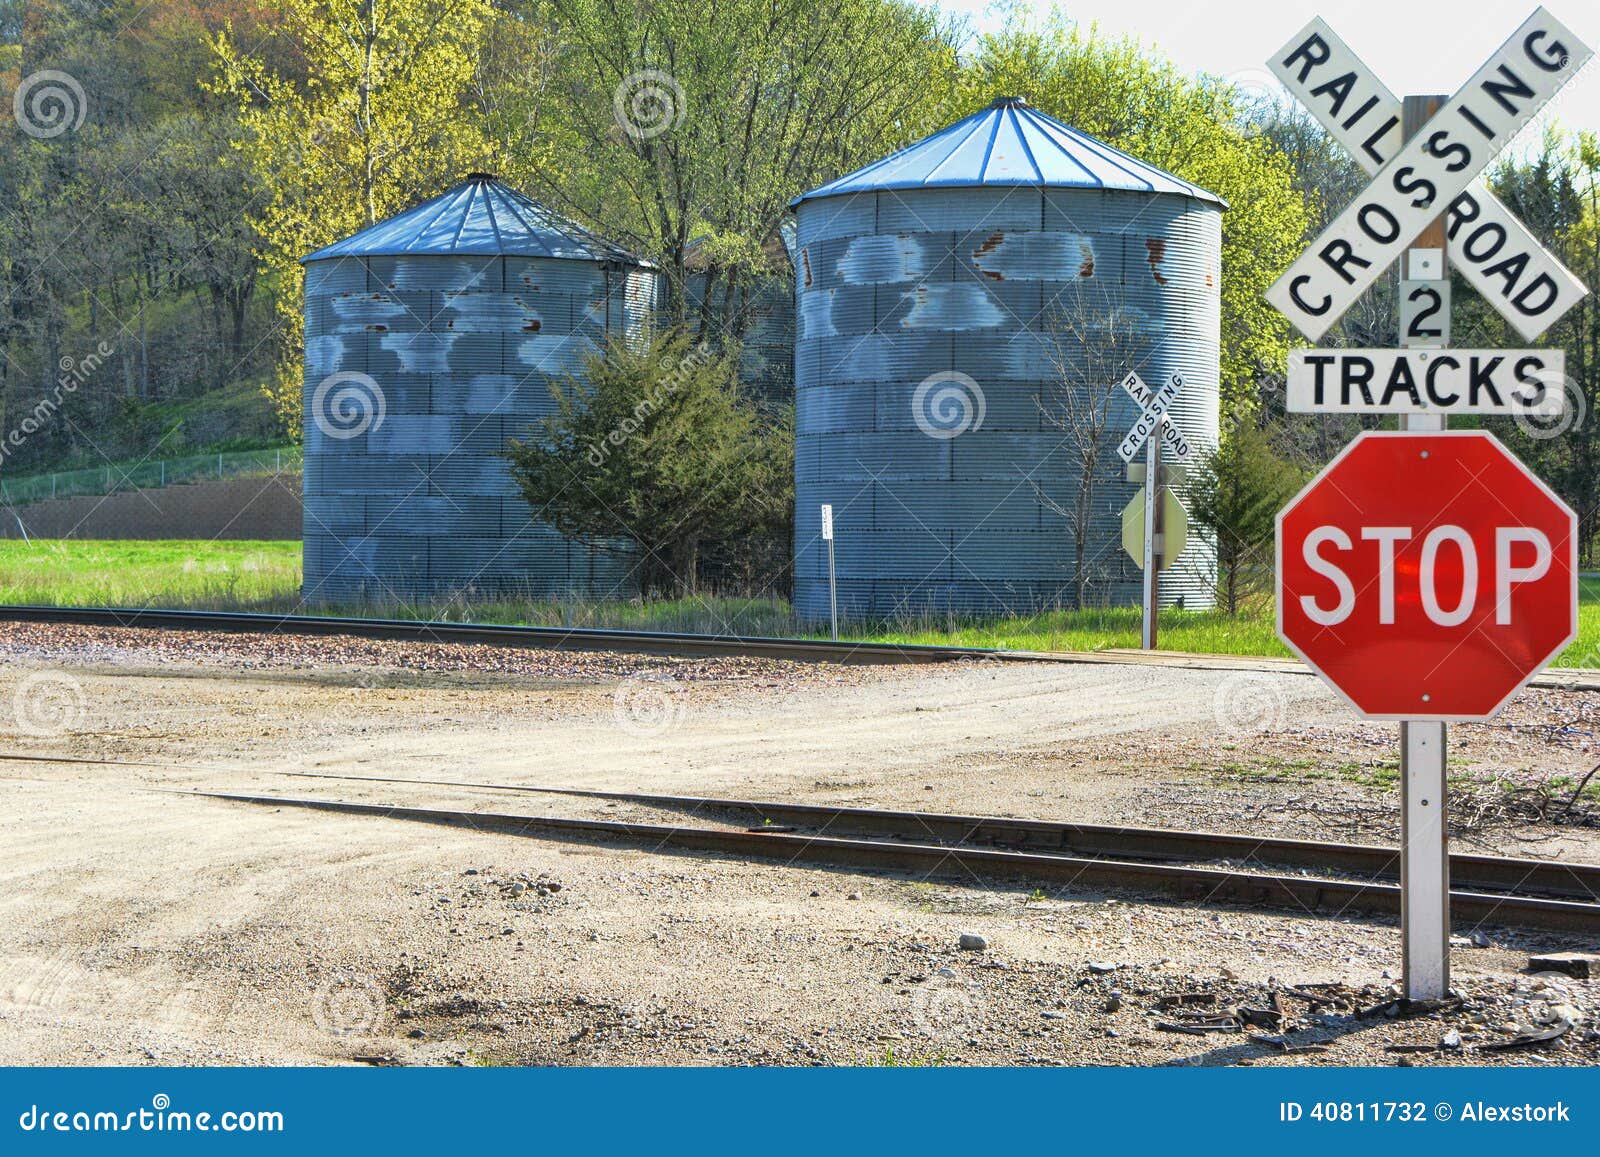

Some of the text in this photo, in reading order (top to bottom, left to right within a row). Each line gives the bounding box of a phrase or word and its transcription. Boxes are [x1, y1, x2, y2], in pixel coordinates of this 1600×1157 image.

[1281, 32, 1400, 166] RAIL
[1288, 29, 1569, 317] CROSSING
[1446, 190, 1560, 318] ROAD
[1406, 287, 1443, 339] 2
[1122, 375, 1182, 457] CROSSING
[1303, 355, 1548, 406] TRACKS
[1161, 420, 1188, 456] ROAD
[1299, 524, 1553, 627] STOP
